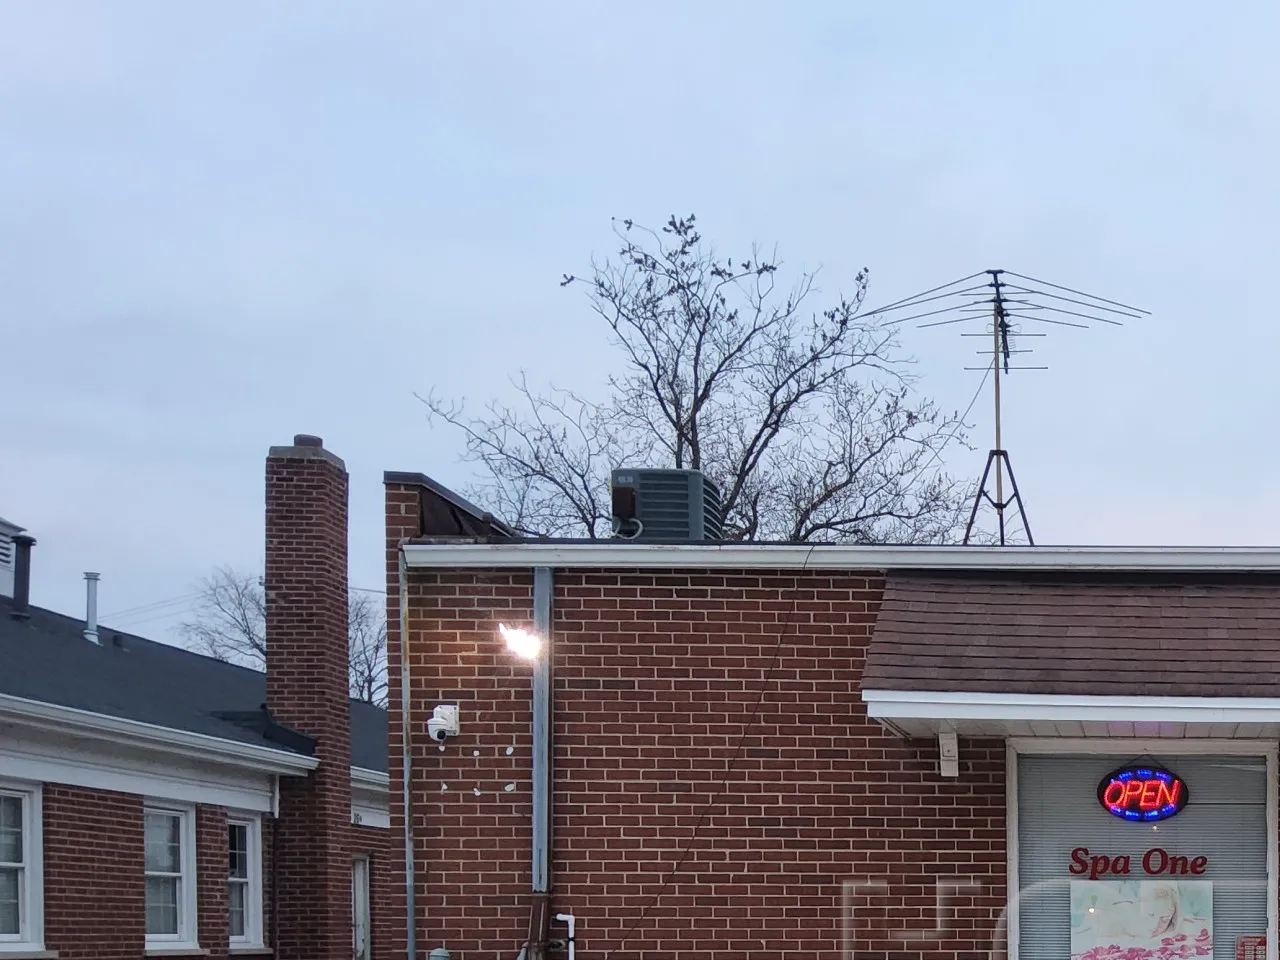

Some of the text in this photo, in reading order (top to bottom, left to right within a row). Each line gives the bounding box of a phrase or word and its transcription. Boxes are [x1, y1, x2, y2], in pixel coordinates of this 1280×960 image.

[1103, 779, 1180, 809] OPEN
[1068, 847, 1208, 880] Spa One
